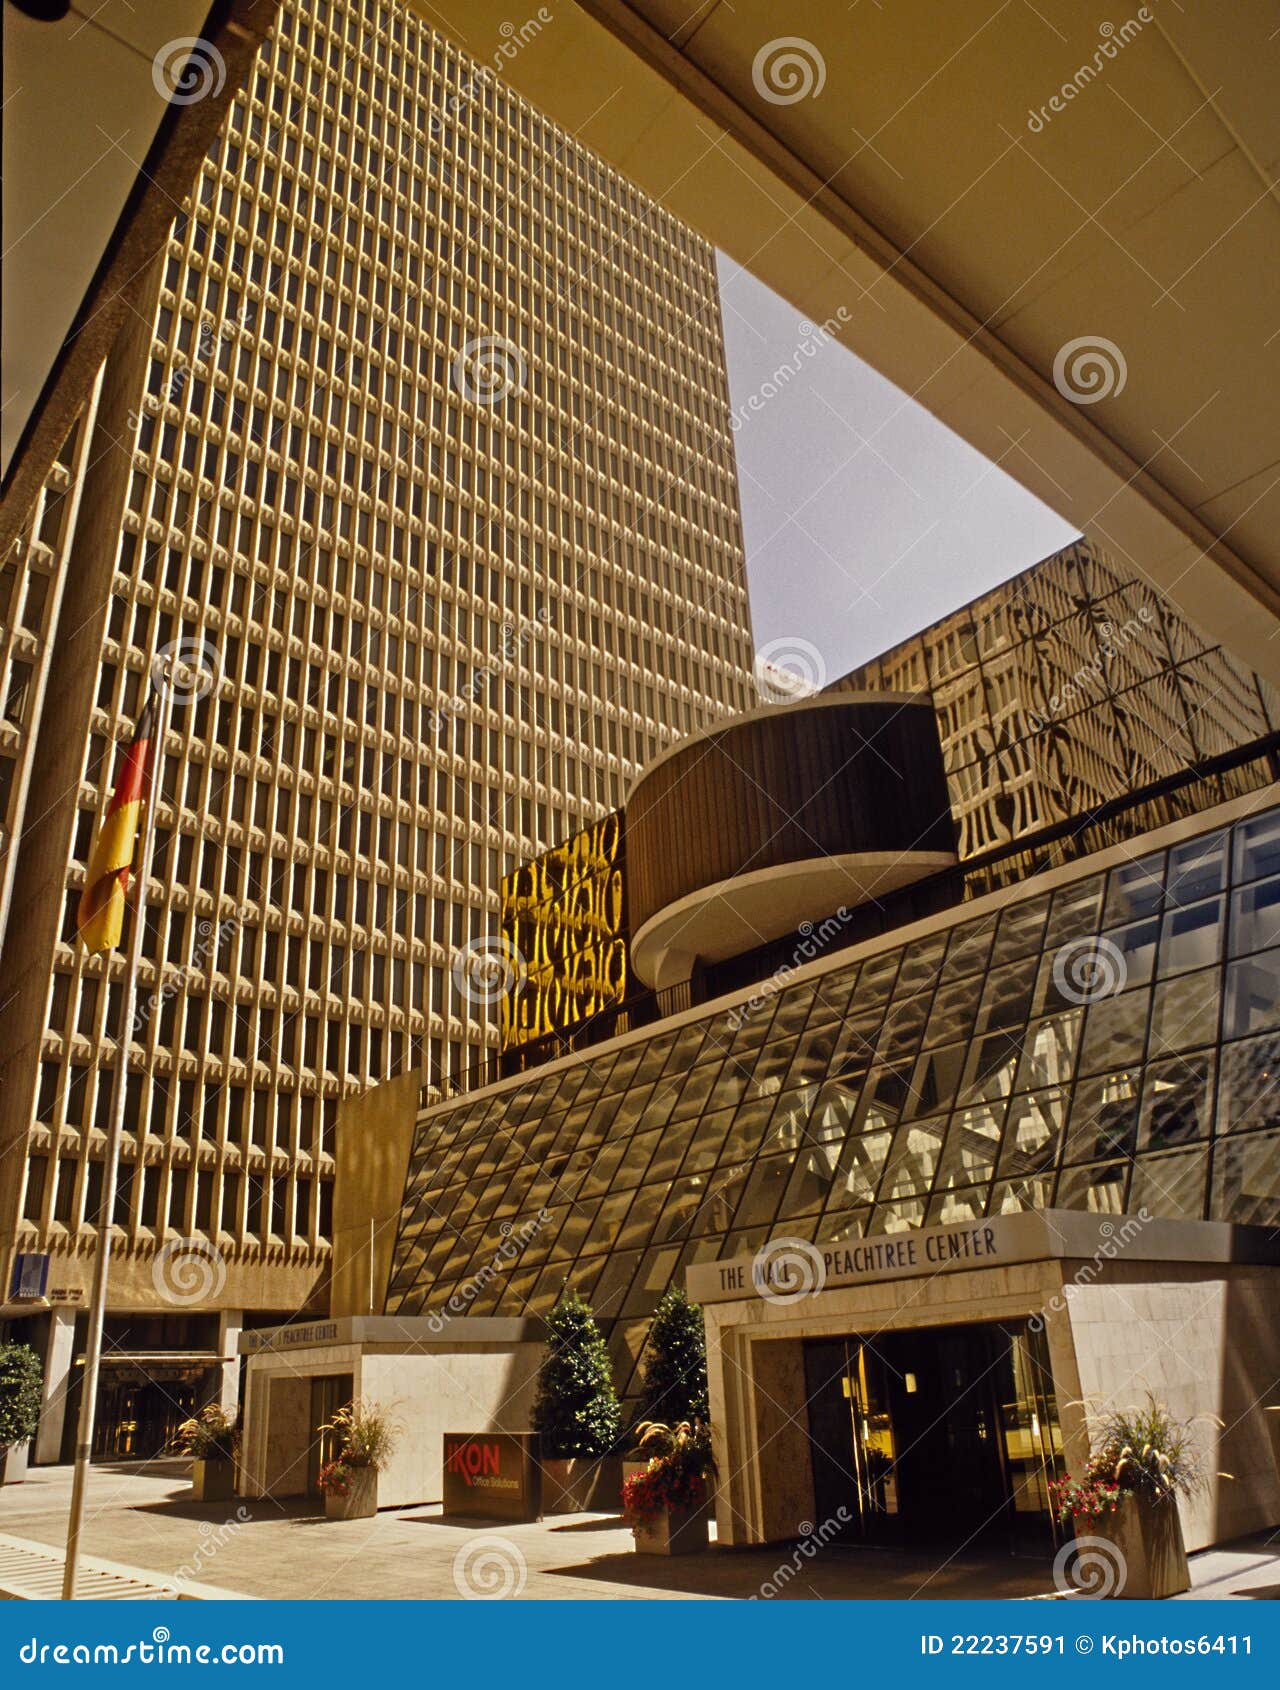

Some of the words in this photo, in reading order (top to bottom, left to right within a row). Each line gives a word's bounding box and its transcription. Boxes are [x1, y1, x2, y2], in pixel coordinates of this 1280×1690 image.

[719, 1266, 744, 1291] THE
[824, 1239, 917, 1276] PEACHTREE
[926, 1228, 997, 1262] CENTER
[447, 1443, 500, 1487] IKON
